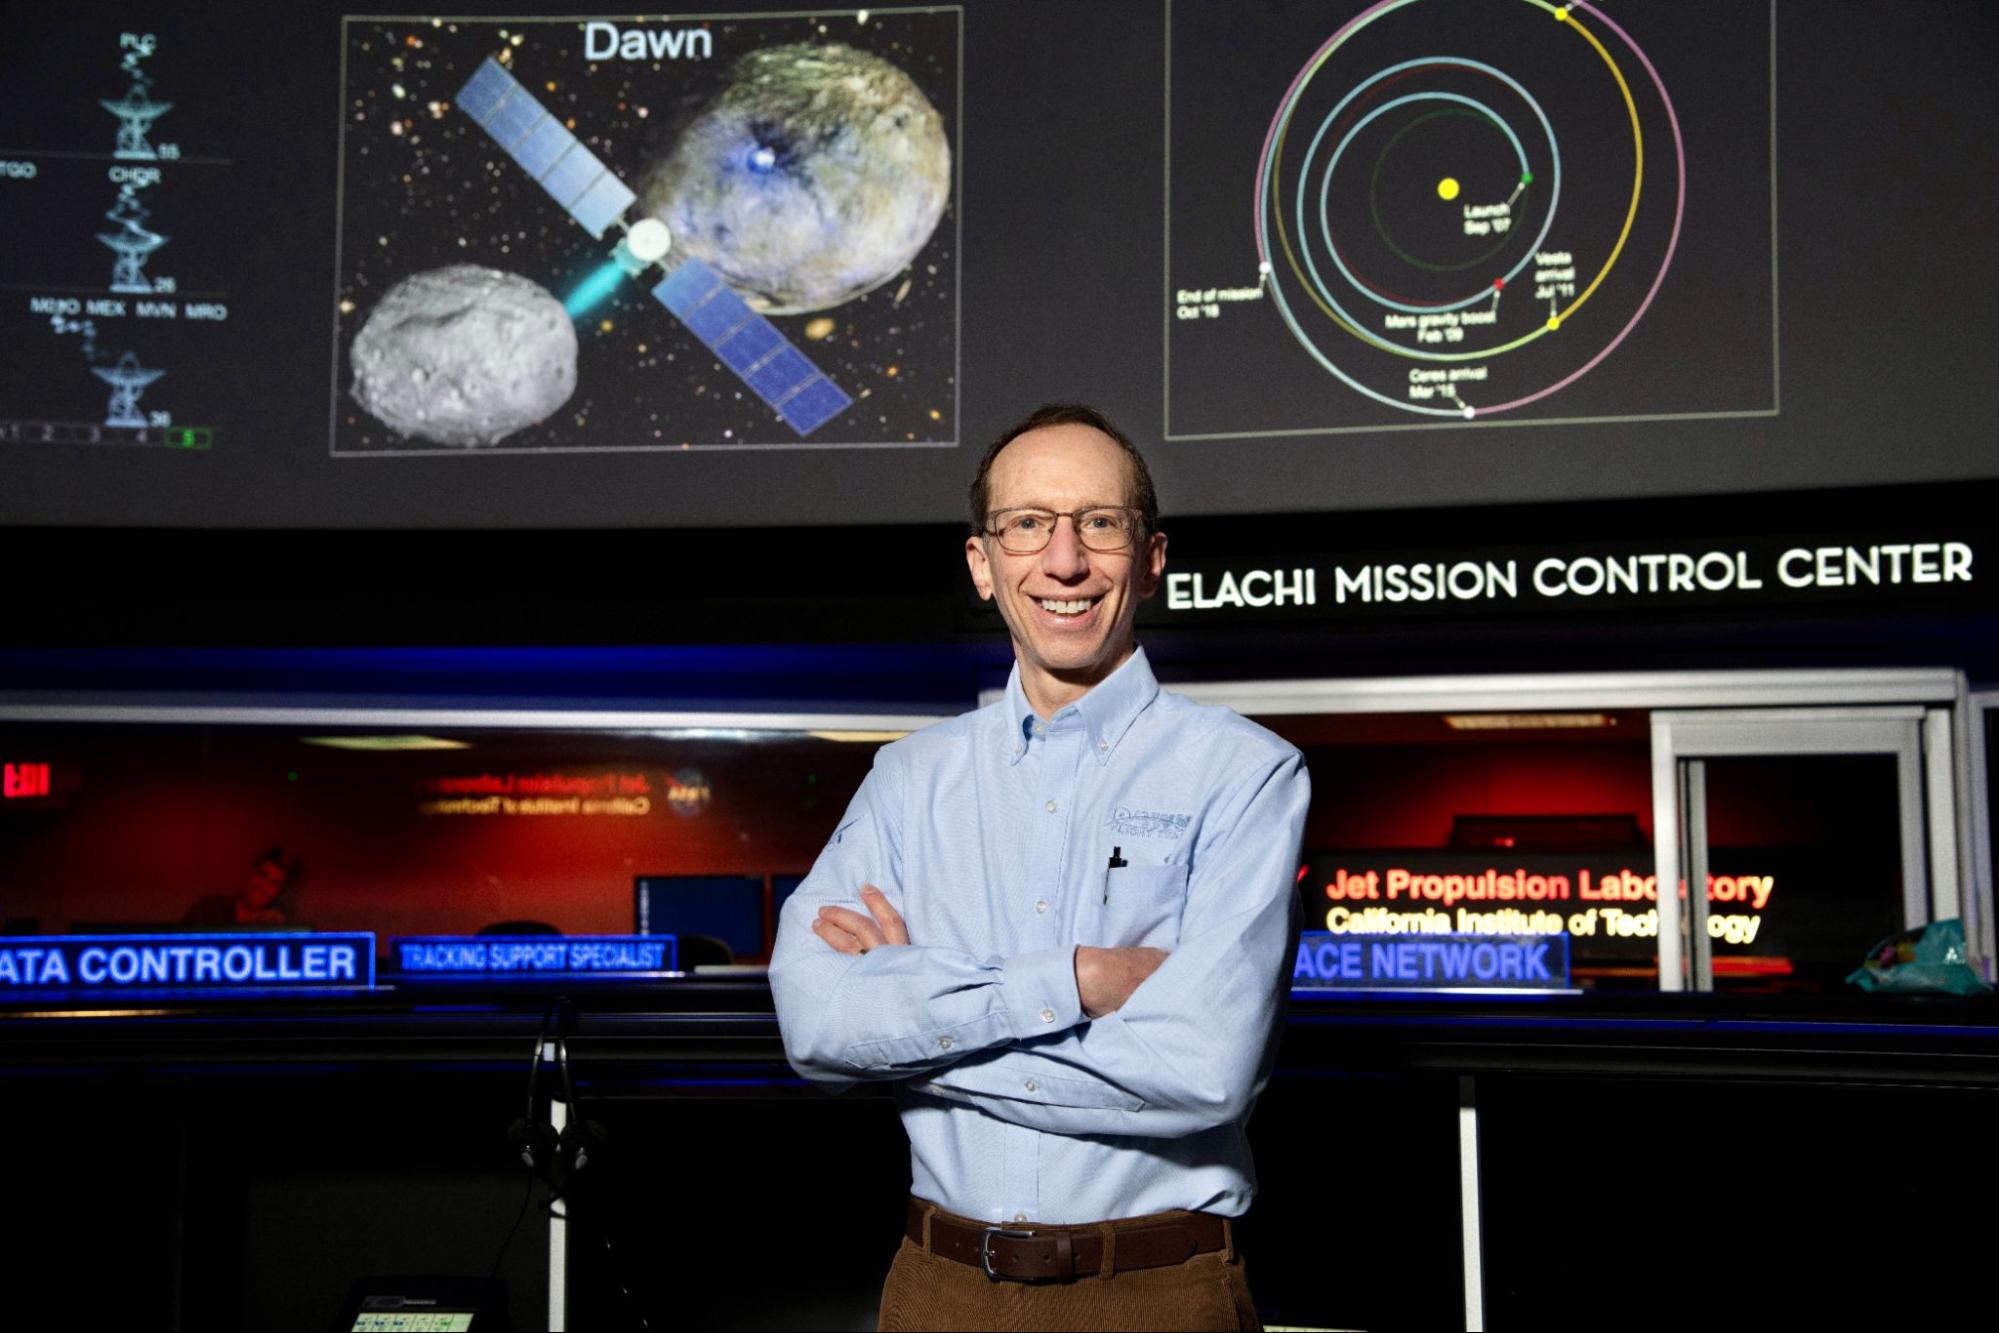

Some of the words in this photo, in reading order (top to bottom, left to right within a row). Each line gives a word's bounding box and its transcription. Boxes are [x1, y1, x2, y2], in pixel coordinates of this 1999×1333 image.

[585, 22, 712, 60] Dawn
[1464, 203, 1511, 219] Launch
[1464, 220, 1491, 236] Sep
[1535, 251, 1572, 266] Vesta
[1535, 267, 1576, 283] arrival
[1177, 288, 1202, 304] End
[1203, 287, 1217, 303] of
[1218, 286, 1264, 301] mission
[1535, 283, 1556, 299] Jul
[86, 299, 126, 316] MEX
[185, 303, 228, 320] MRO
[1177, 305, 1200, 320] Oct
[1385, 314, 1416, 329] Mars
[1418, 312, 1459, 330] gravity
[1461, 308, 1497, 325] boost
[1417, 329, 1443, 343] Feb
[1409, 368, 1447, 383] Ceres
[1448, 365, 1488, 381] arrival
[1409, 385, 1434, 399] Mar
[1167, 568, 1316, 609] ELACHI
[1335, 561, 1517, 603] MISSION
[1533, 551, 1763, 597] CONTROL
[1777, 542, 1973, 588] CENTER
[1326, 869, 1380, 899] Jet
[1387, 869, 1569, 907] Propulsion
[1579, 869, 1774, 909] Laboory
[1326, 906, 1451, 934] California
[1457, 907, 1563, 935] Institute
[1568, 908, 1597, 936] of
[1599, 908, 1761, 944] Techogy
[0, 949, 69, 983] ATA
[79, 946, 356, 982] CONTROLLER
[402, 944, 485, 970] TRACKING
[490, 943, 567, 970] SUPPORT
[570, 943, 666, 970] SPECIALIST
[1372, 943, 1549, 980] NETWORK
